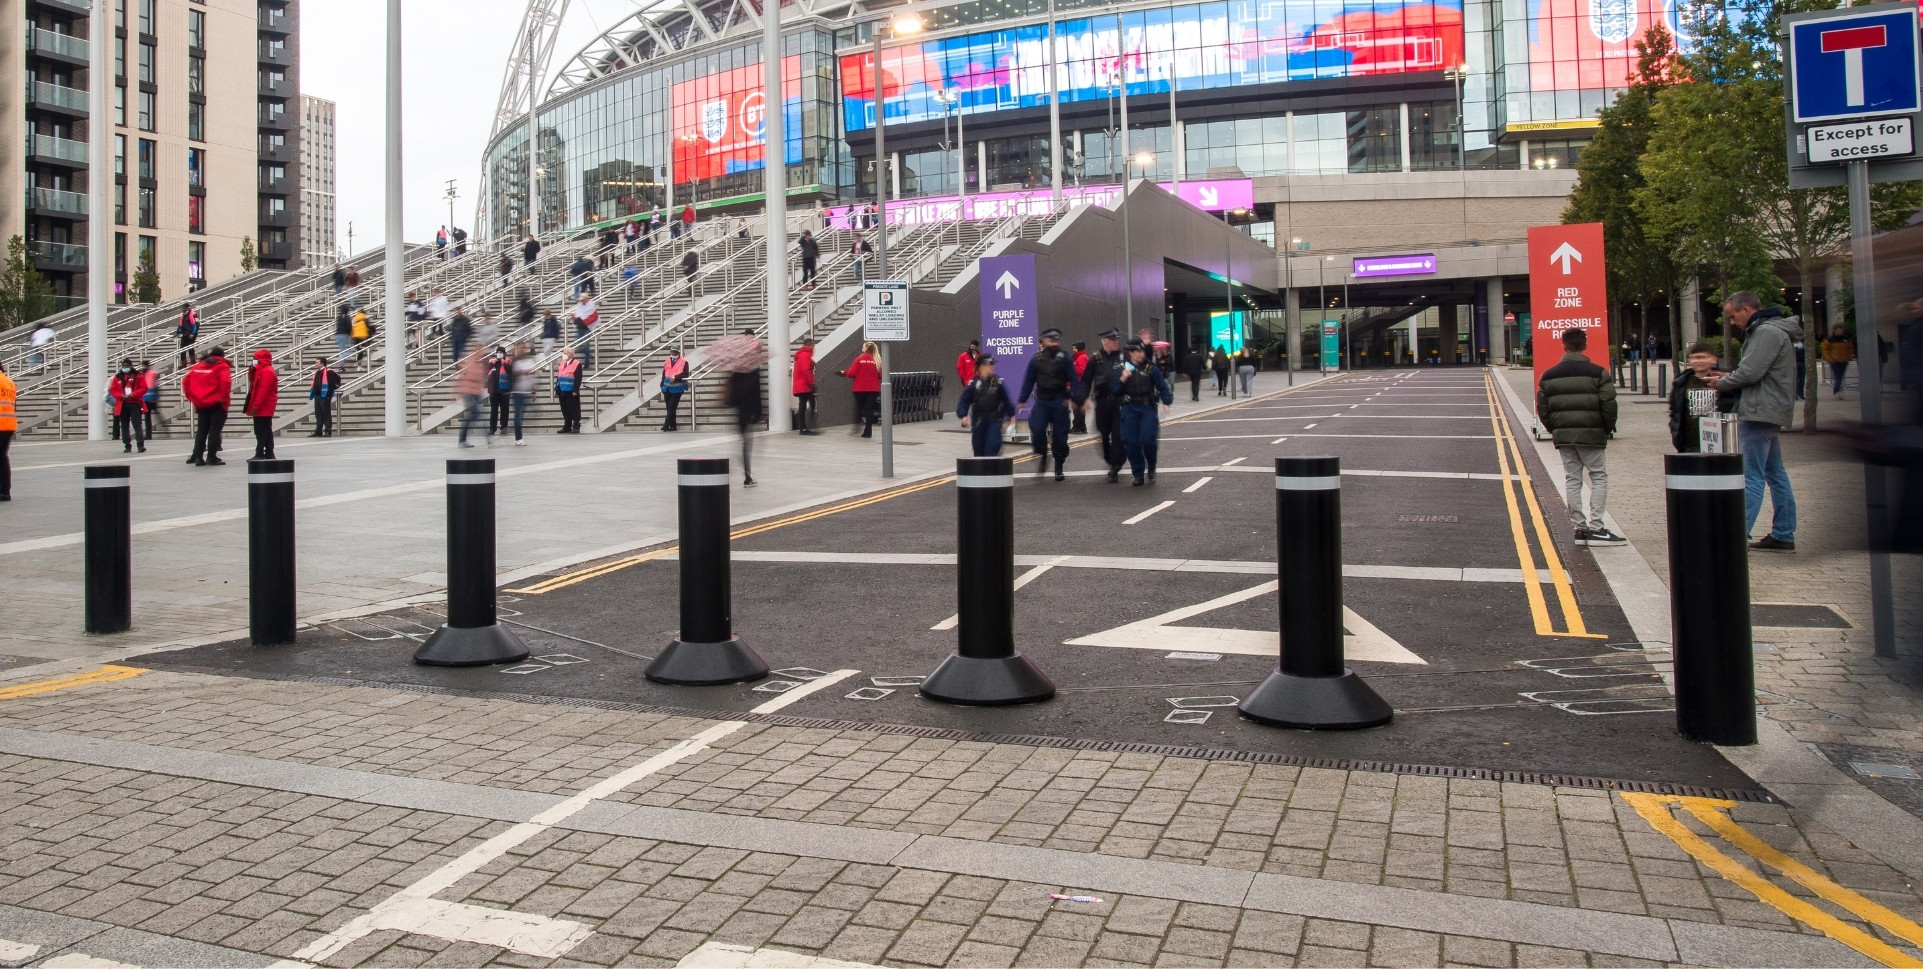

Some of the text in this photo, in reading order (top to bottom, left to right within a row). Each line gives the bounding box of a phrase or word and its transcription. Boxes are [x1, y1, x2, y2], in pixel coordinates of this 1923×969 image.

[747, 104, 766, 124] BT
[1814, 124, 1904, 142] Except for
[1830, 144, 1889, 158] access
[1557, 287, 1579, 298] RED
[1554, 297, 1582, 308] ZONE
[993, 309, 1025, 320] PURPLE
[998, 319, 1020, 328] ZONE
[1537, 317, 1602, 330] ACCESSIBLE
[986, 336, 1034, 347] ACCESSIBLE
[996, 345, 1024, 356] ROUTE
[1688, 389, 1718, 400] FUTURE
